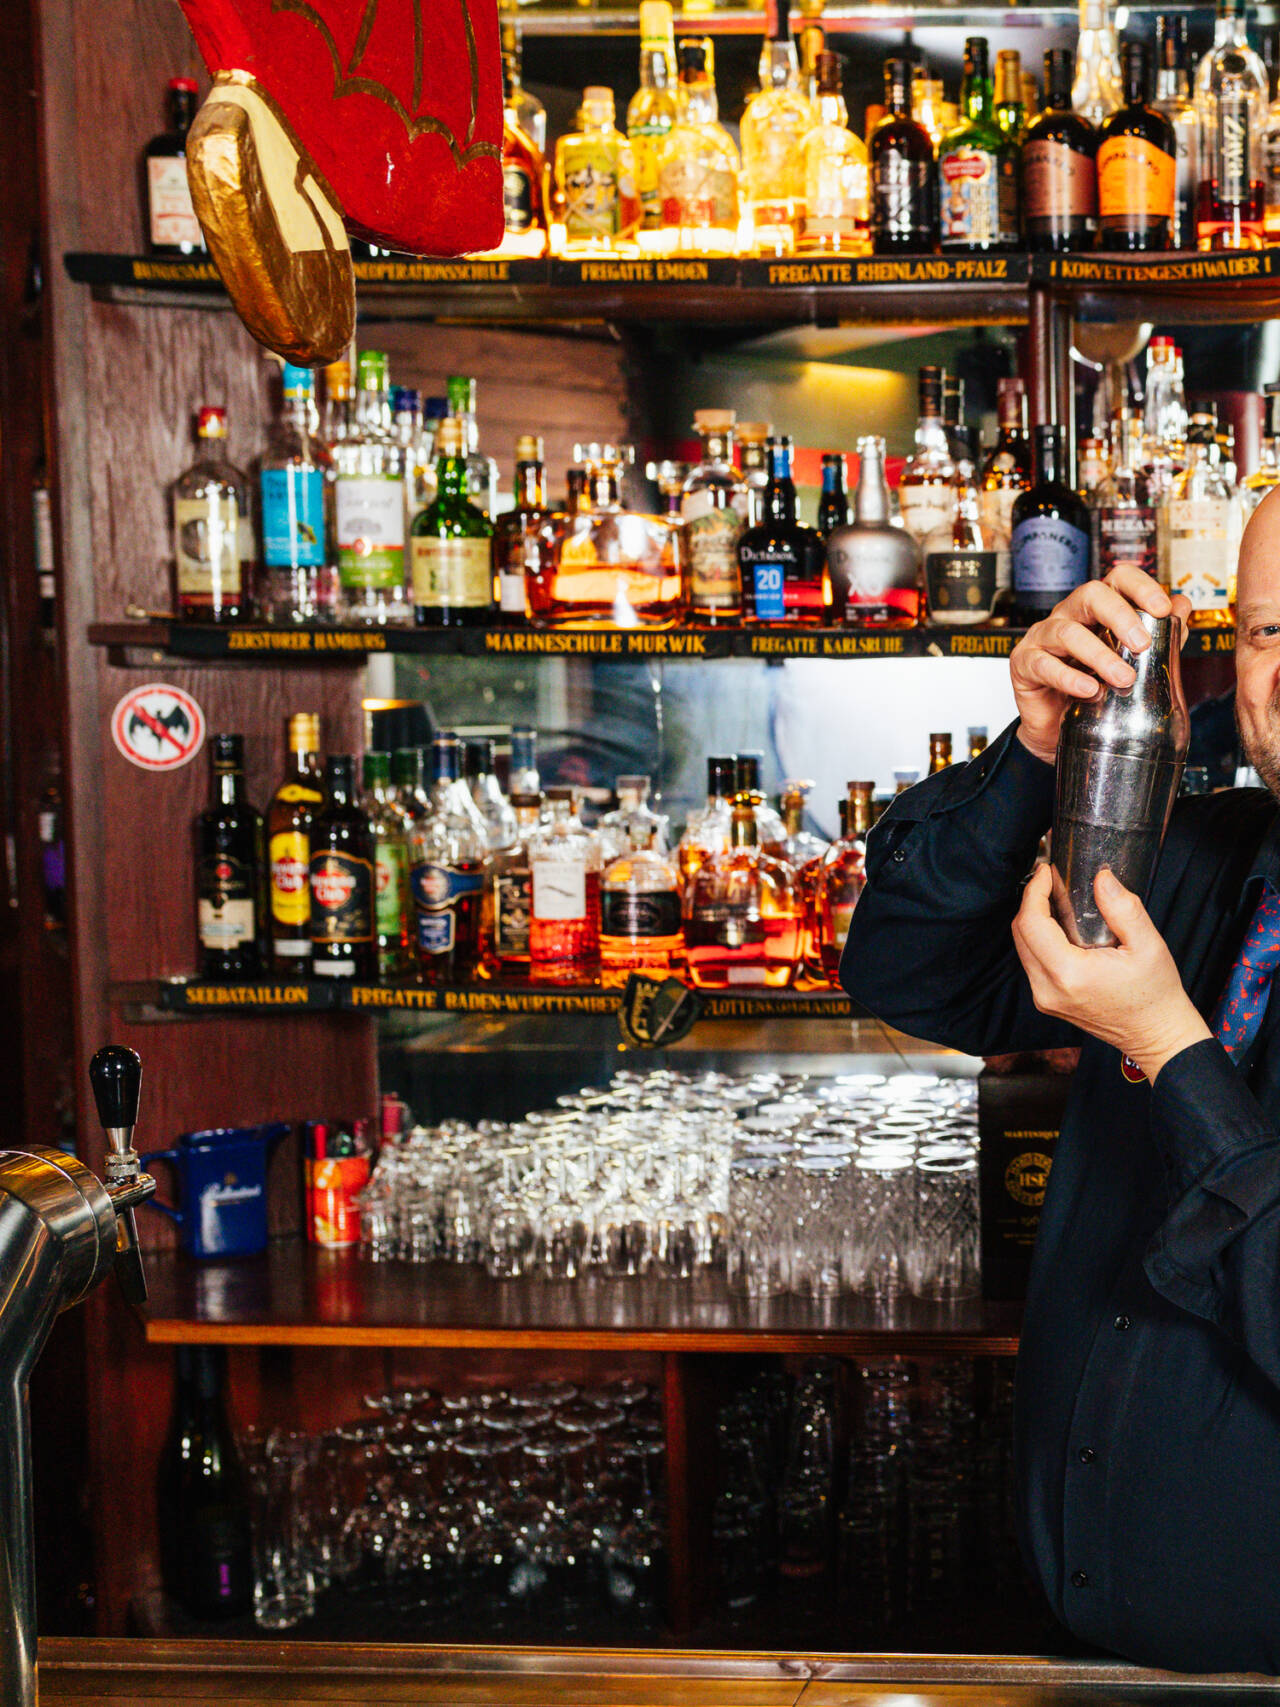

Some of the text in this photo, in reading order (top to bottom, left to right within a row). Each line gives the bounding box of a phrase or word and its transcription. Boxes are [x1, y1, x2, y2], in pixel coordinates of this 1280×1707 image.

[769, 260, 1008, 284] FREGATTE RHEINLAND-PFALZ
[757, 568, 781, 591] 20
[485, 633, 623, 653] MARINESCHULE
[752, 636, 905, 656] FREGATTE KARLSRUHE
[1201, 634, 1212, 651] 3
[351, 987, 437, 1009] FREGATTE
